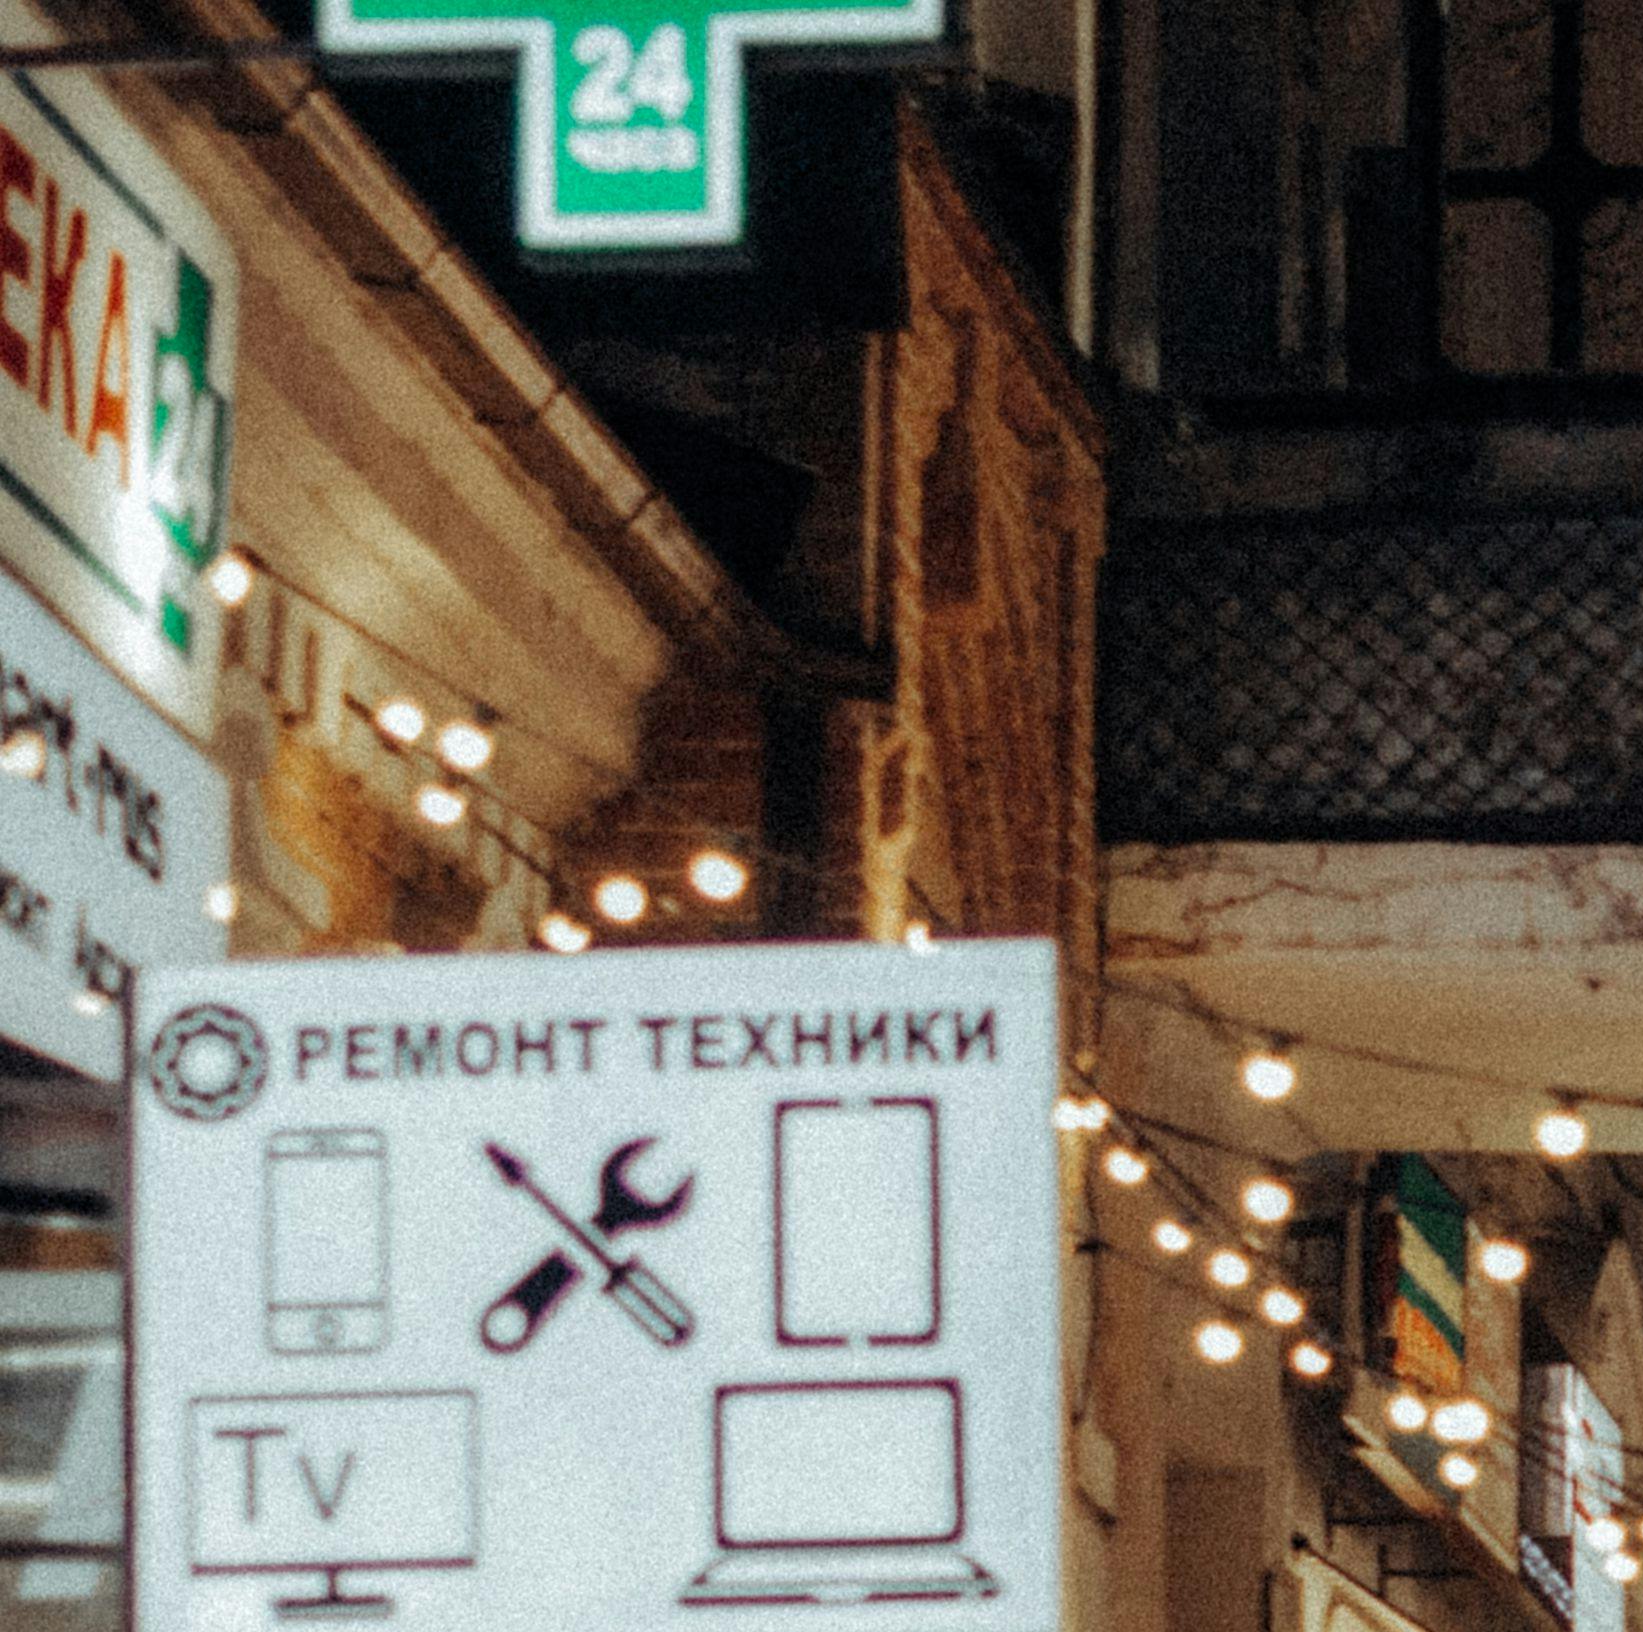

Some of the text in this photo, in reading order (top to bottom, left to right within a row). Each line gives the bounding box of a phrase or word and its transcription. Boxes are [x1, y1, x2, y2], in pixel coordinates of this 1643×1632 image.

[568, 23, 694, 125] 24
[295, 1008, 1001, 1081] РЕМОНТ ТЕХНИКИ
